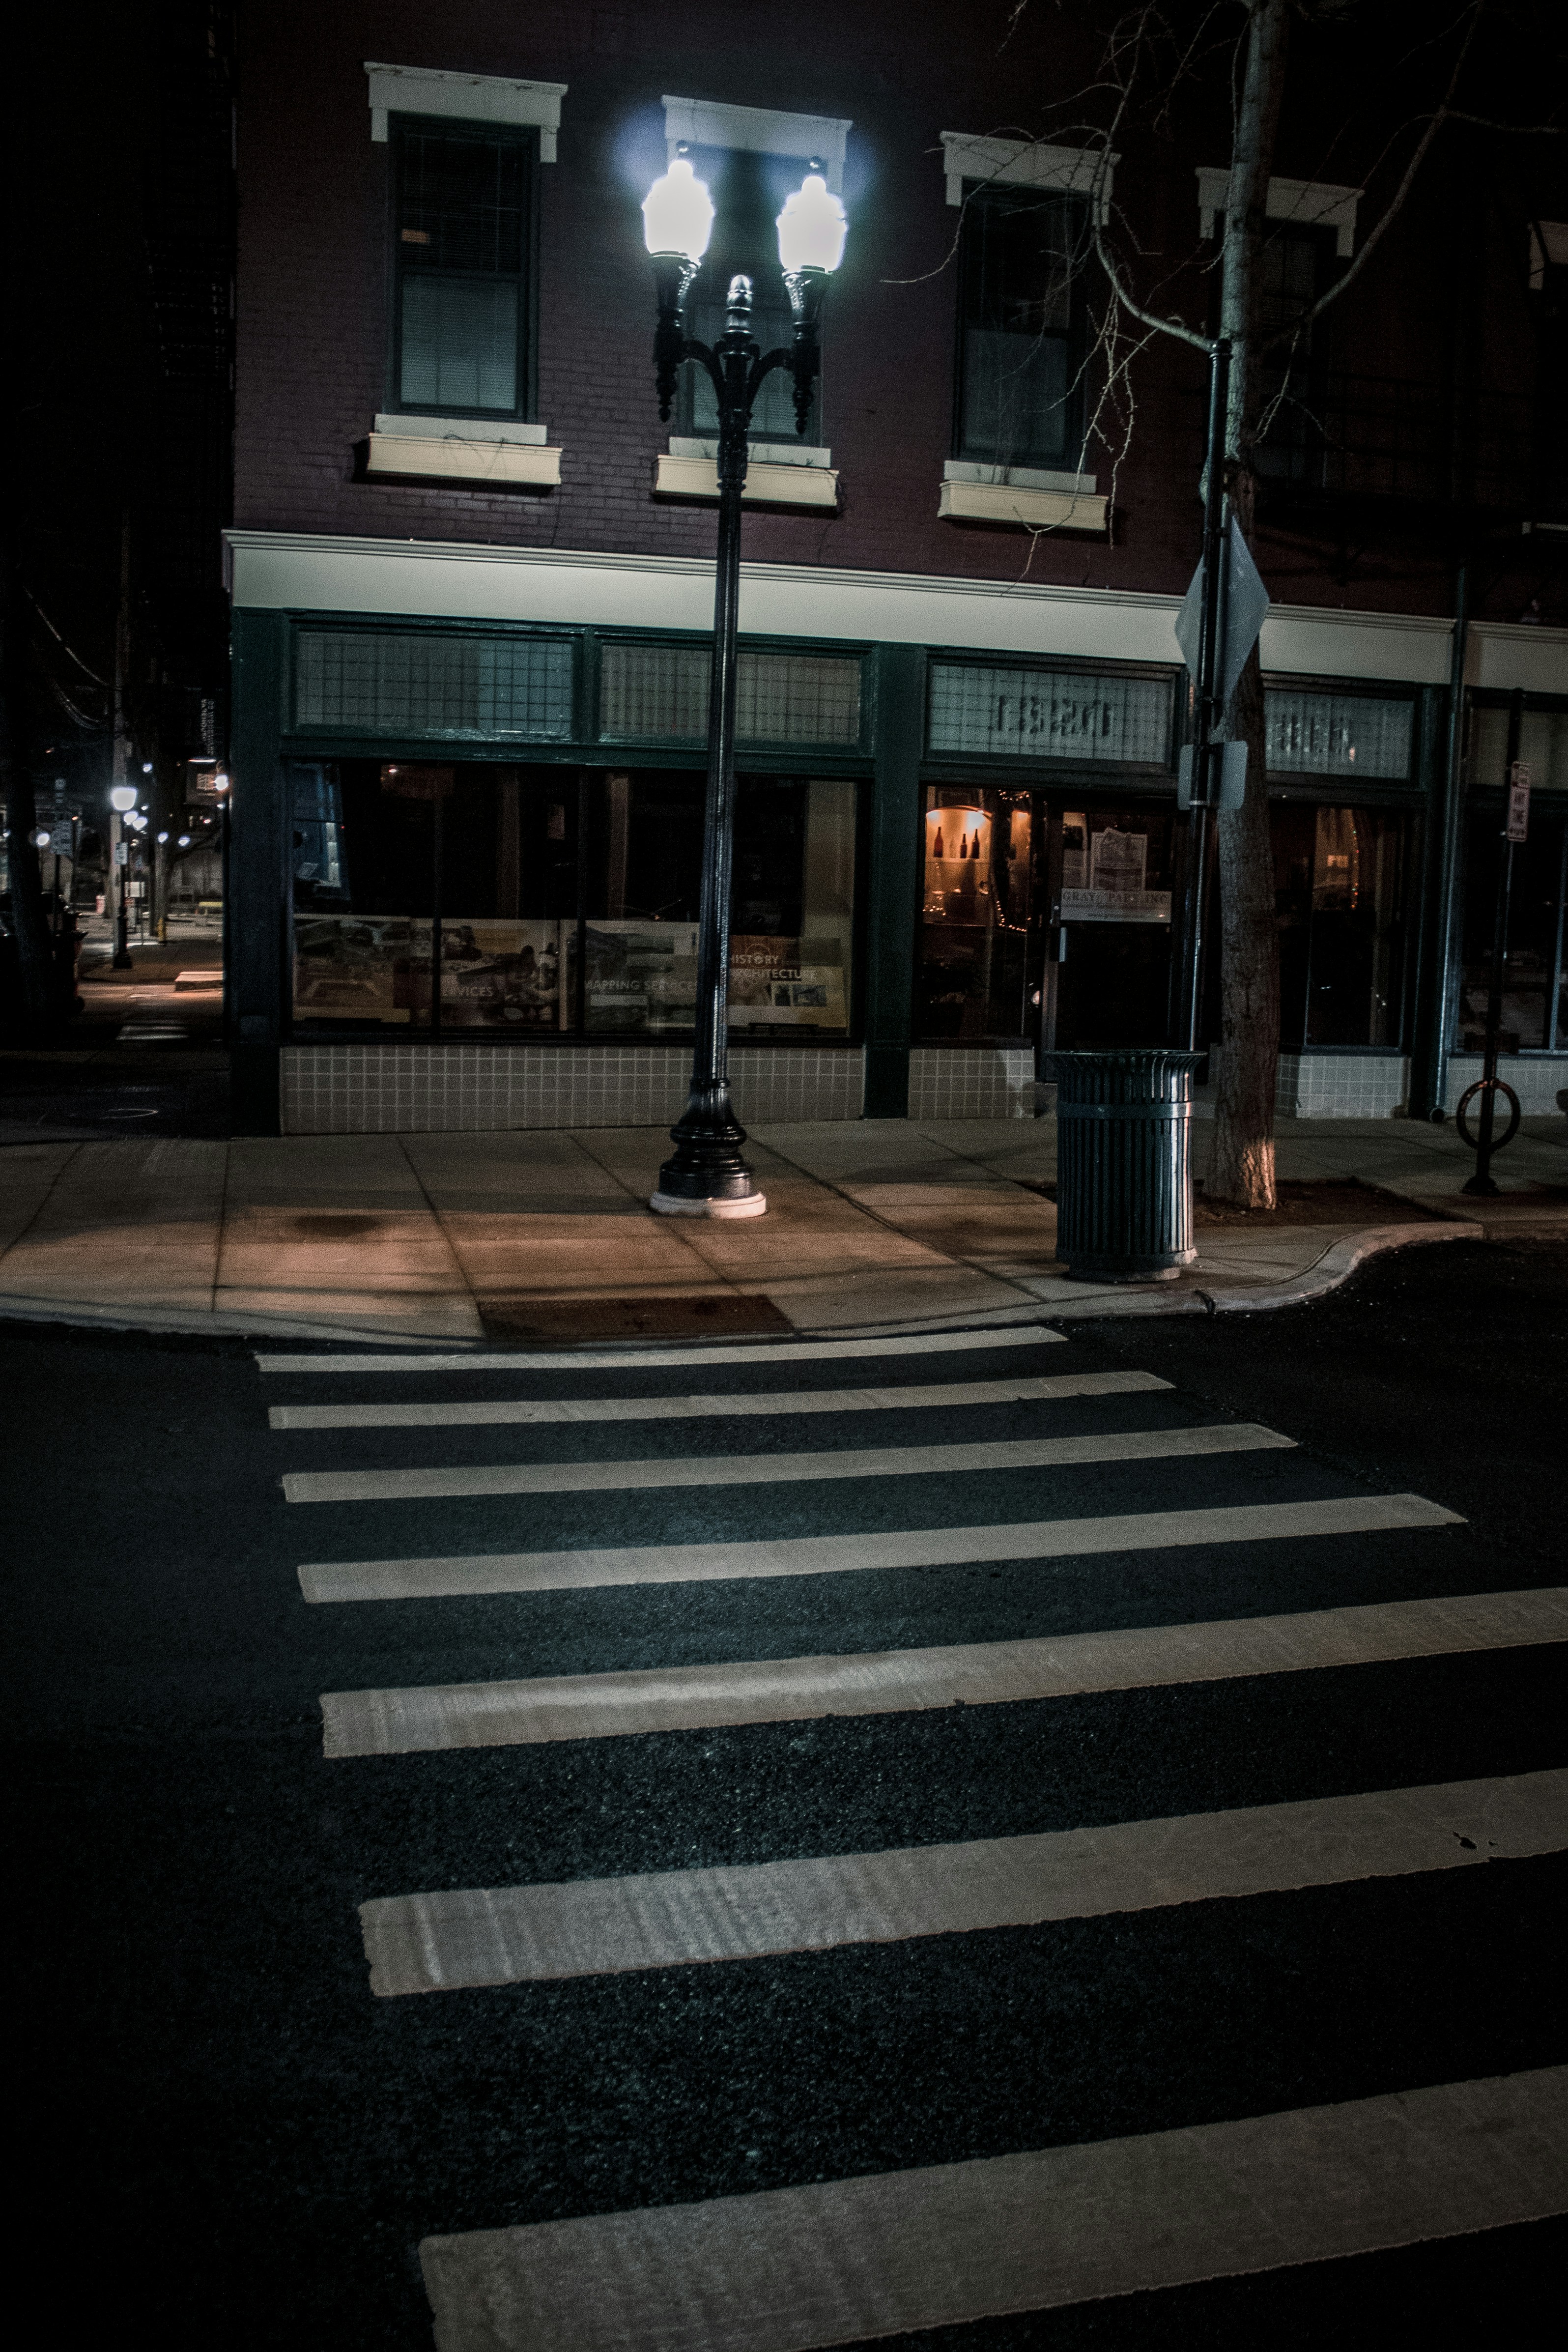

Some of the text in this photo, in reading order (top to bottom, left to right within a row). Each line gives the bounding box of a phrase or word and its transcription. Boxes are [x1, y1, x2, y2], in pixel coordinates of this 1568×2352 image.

[1062, 891, 1096, 902] GRAY
[728, 954, 779, 965] HISTORY
[730, 969, 816, 979] RCHITECTURE
